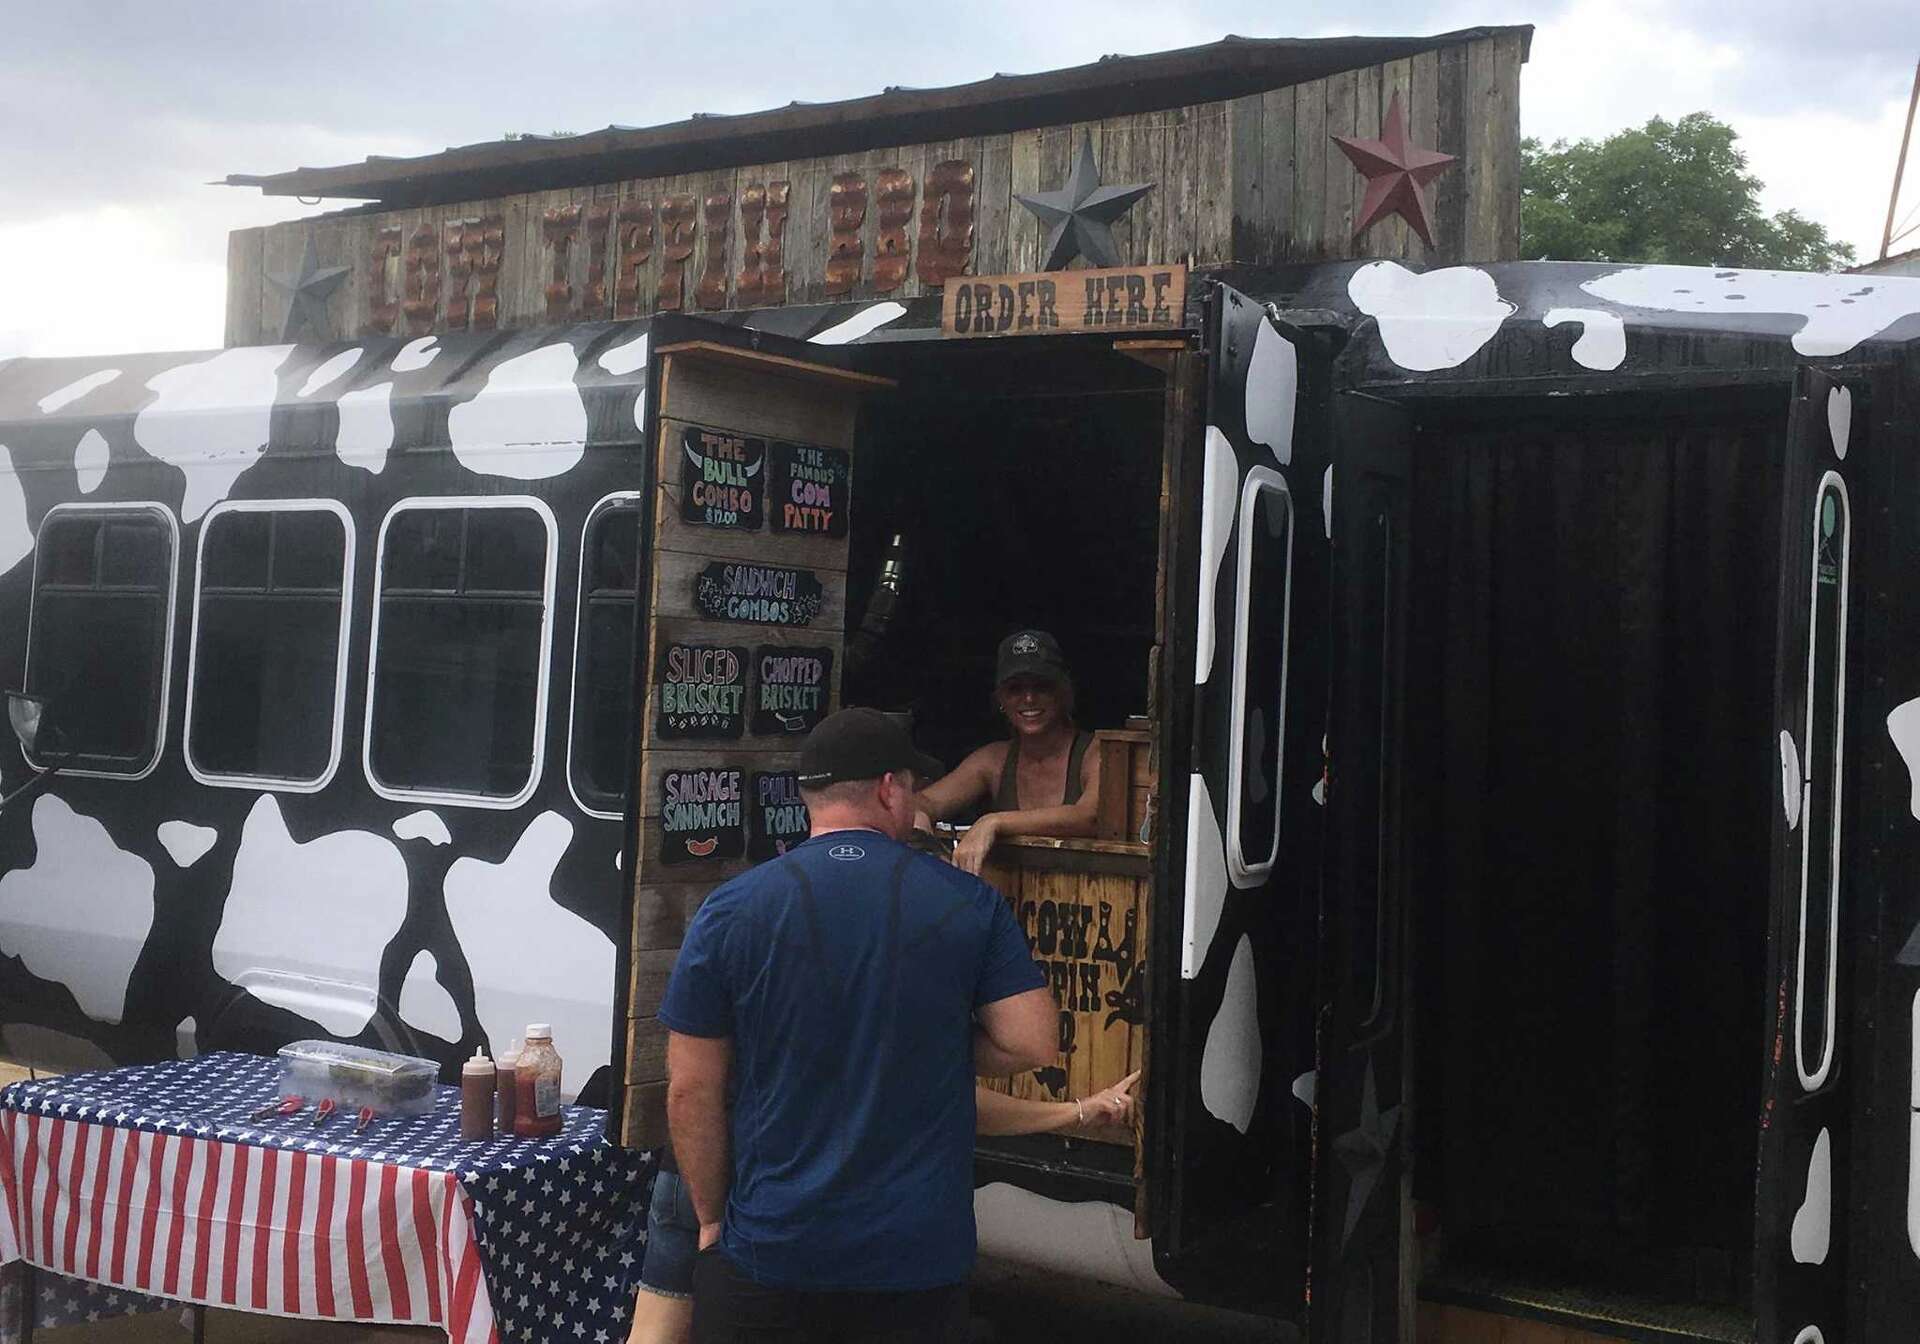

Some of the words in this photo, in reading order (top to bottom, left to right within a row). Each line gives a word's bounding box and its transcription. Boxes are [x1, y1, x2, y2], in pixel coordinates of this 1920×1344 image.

[370, 215, 503, 336] COW
[954, 279, 1059, 334] ORDER
[1083, 272, 1172, 326] HERE
[701, 432, 746, 461] THE
[797, 447, 824, 466] THE
[704, 458, 748, 487] BULL
[790, 463, 835, 483] FAMOUS
[692, 480, 752, 513] COMBO
[791, 479, 831, 507] COW
[783, 503, 833, 531] PATTY
[727, 596, 790, 622] COMBOS
[665, 646, 740, 685] SLICED
[760, 656, 824, 685] CHOPPED
[662, 683, 744, 714] BRISKET
[760, 684, 821, 711] BRISKET
[665, 771, 741, 804] SAUSAGE
[759, 776, 800, 806] PULL
[663, 802, 741, 832] SANDWICH
[764, 805, 808, 834] PORK
[1019, 899, 1093, 958] COW
